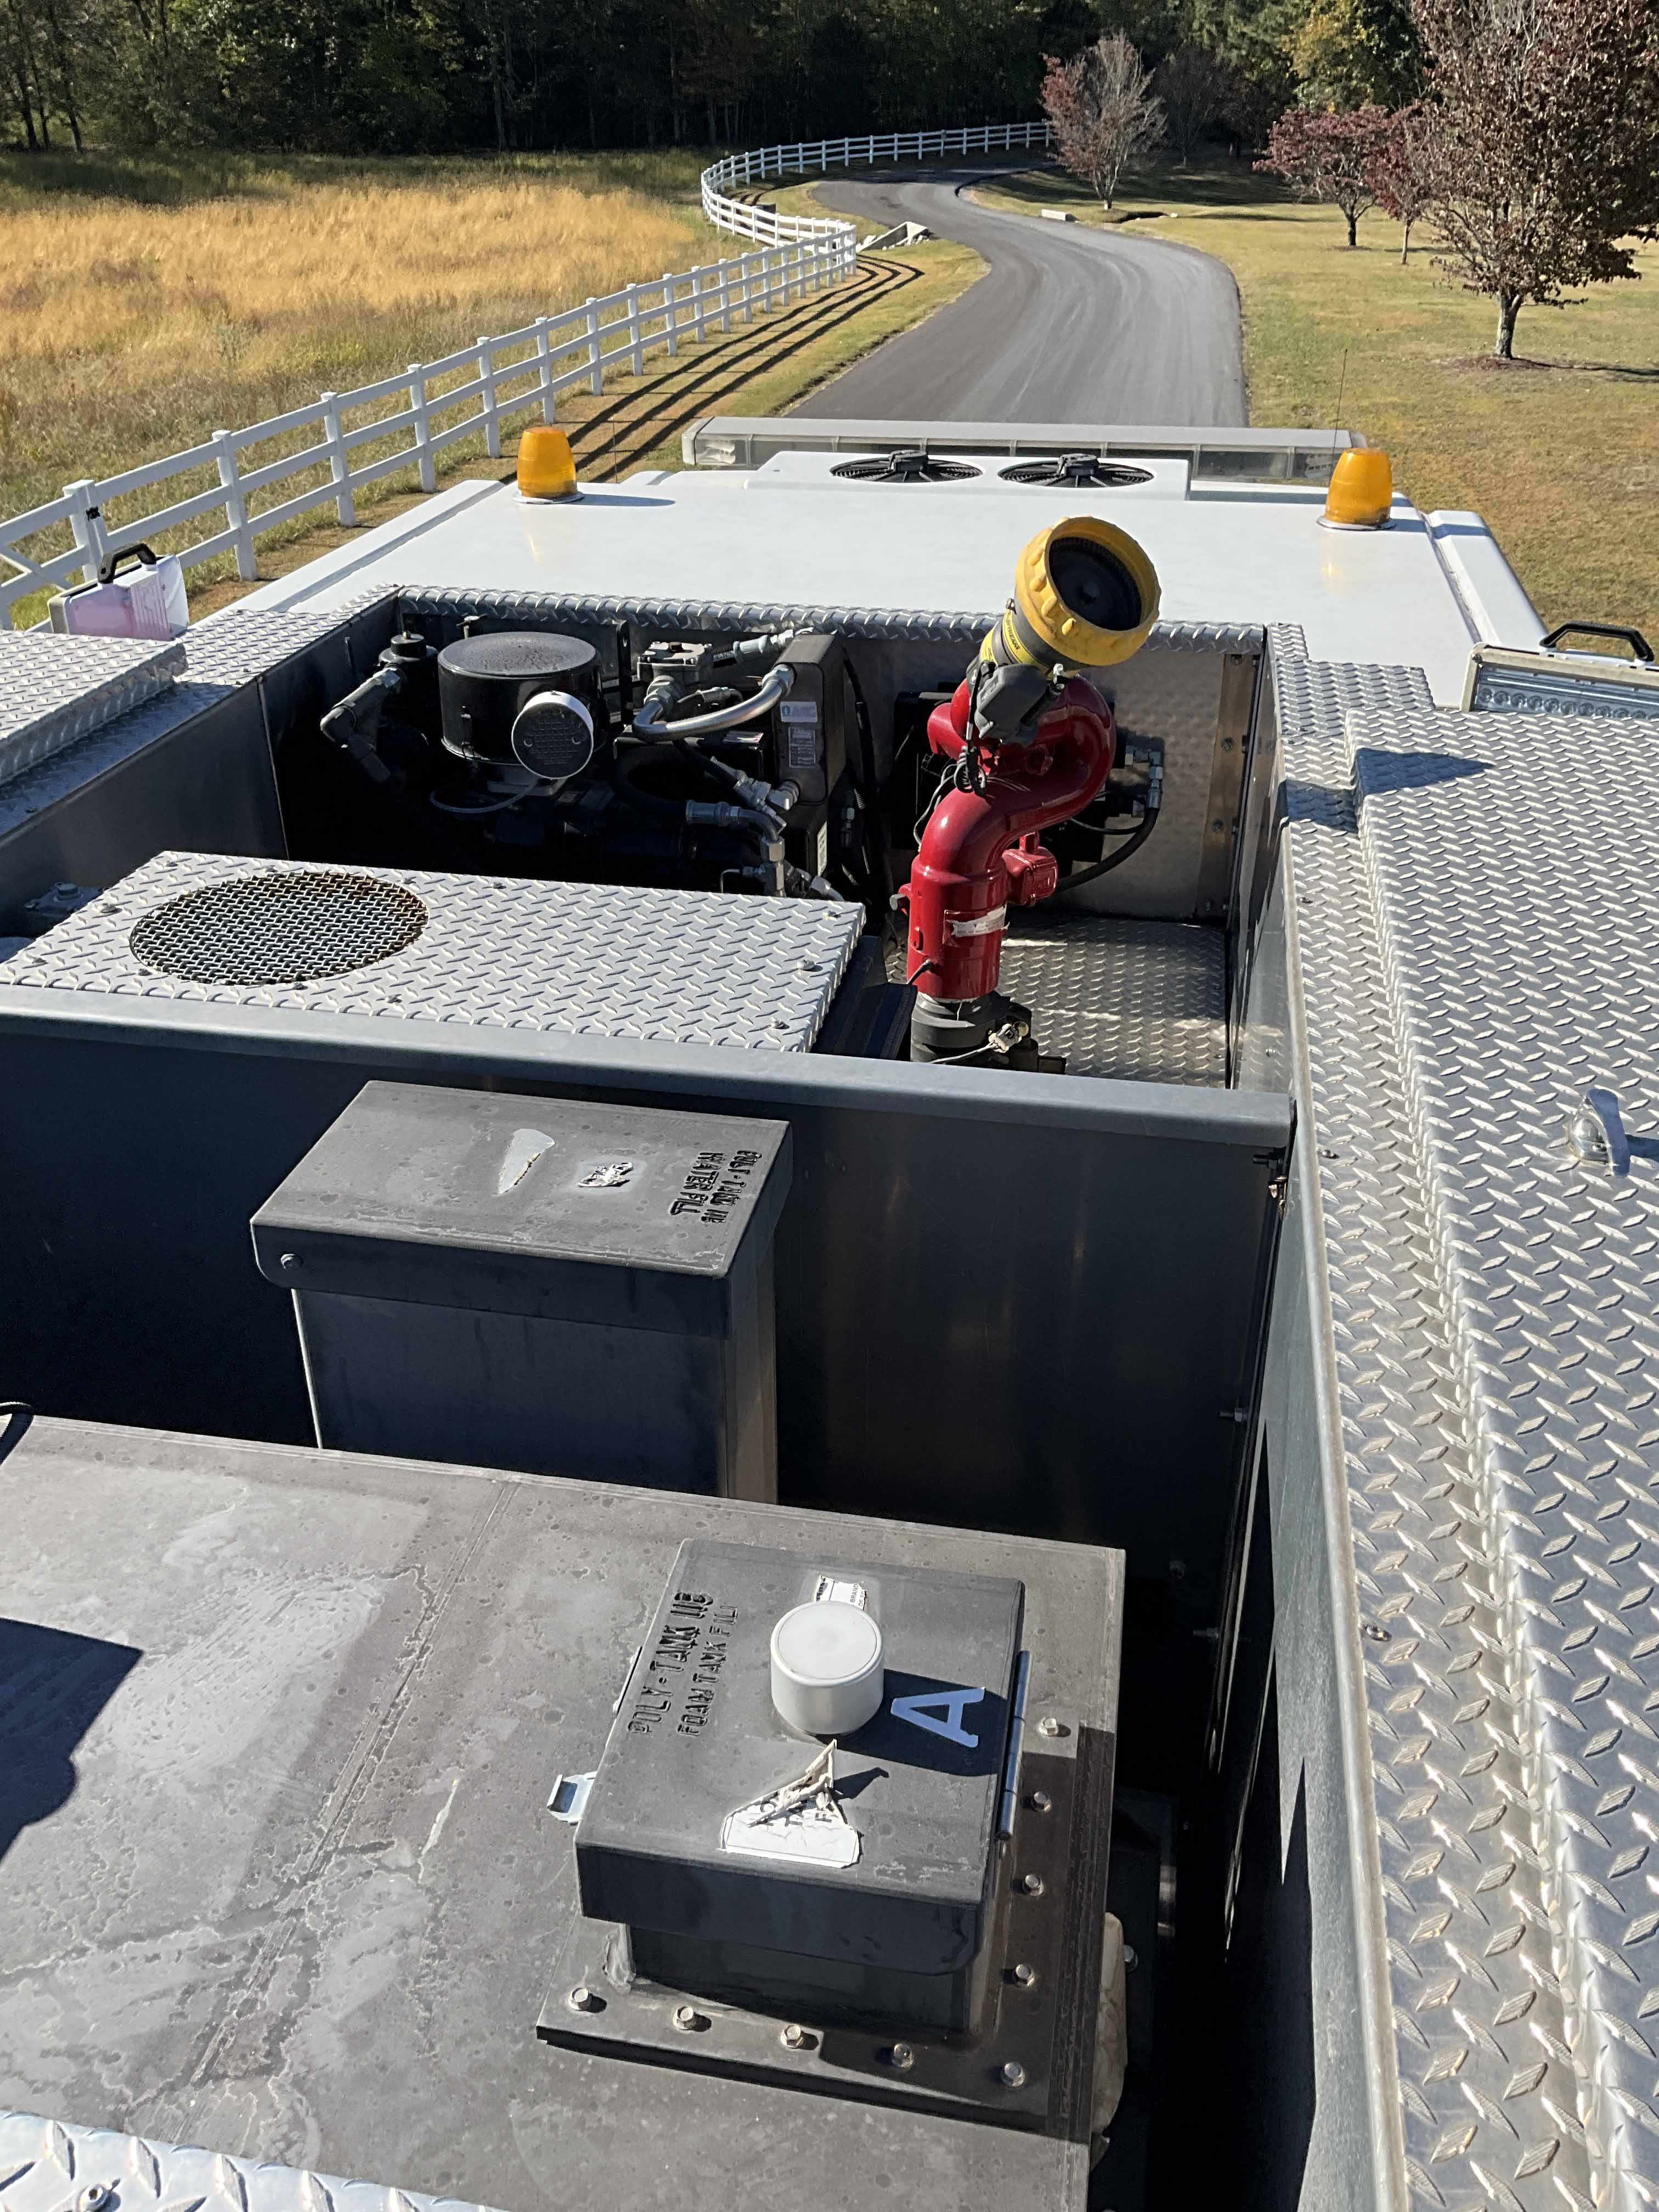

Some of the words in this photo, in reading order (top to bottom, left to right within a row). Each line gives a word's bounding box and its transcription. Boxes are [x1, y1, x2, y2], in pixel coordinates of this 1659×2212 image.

[683, 1152, 725, 1191] WATER
[670, 1192, 709, 1216] FILL
[850, 1583, 859, 1602] BRAND
[692, 1641, 727, 1683] TANK
[676, 1688, 714, 1736] FOAM
[890, 1686, 985, 1748] A
